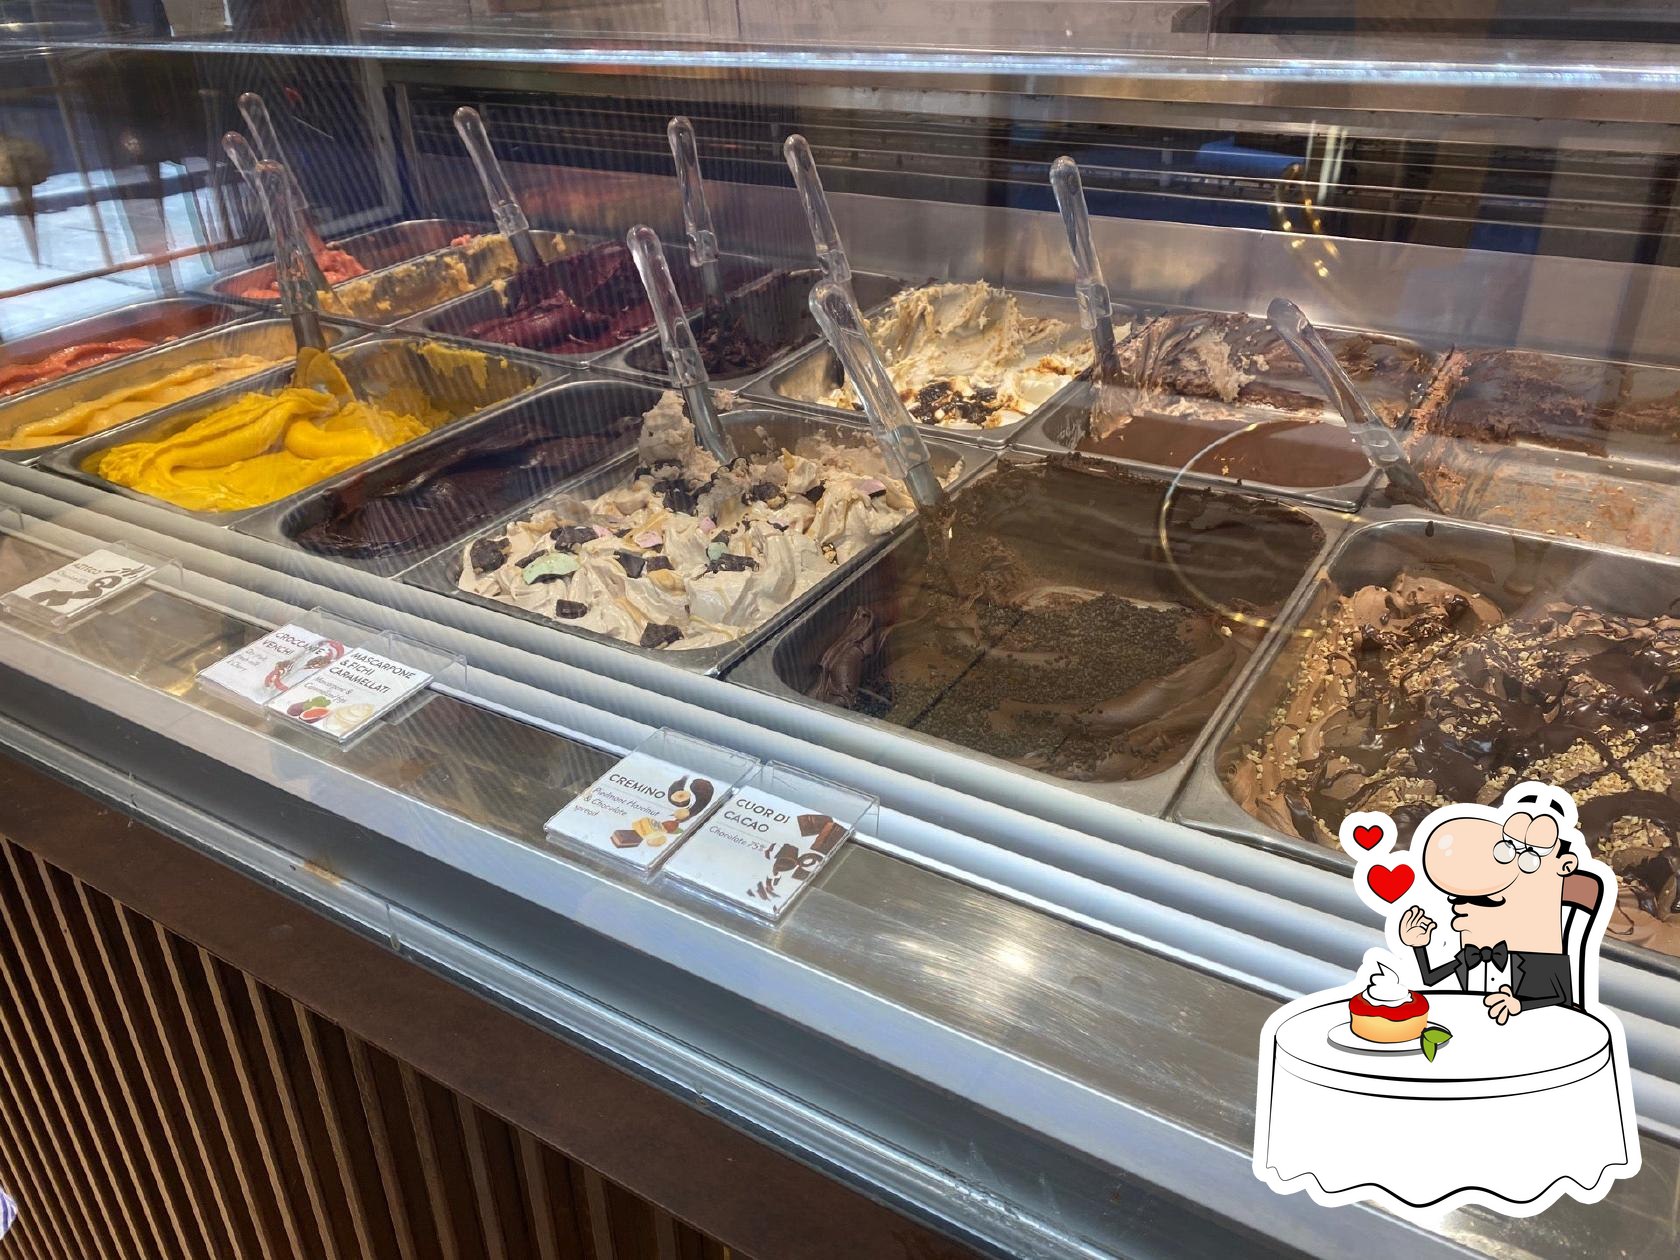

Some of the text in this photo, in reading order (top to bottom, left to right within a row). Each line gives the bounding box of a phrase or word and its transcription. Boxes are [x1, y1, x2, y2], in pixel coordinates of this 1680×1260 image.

[348, 662, 375, 676] FICHI
[351, 653, 416, 679] MASCARPONE
[329, 667, 391, 693] CARAMELLATI
[609, 774, 665, 799] CREMINO
[591, 798, 627, 816] Chocolate
[736, 799, 790, 824] CUOR DI
[724, 811, 769, 832] CACAO
[709, 825, 748, 846] Chocolate
